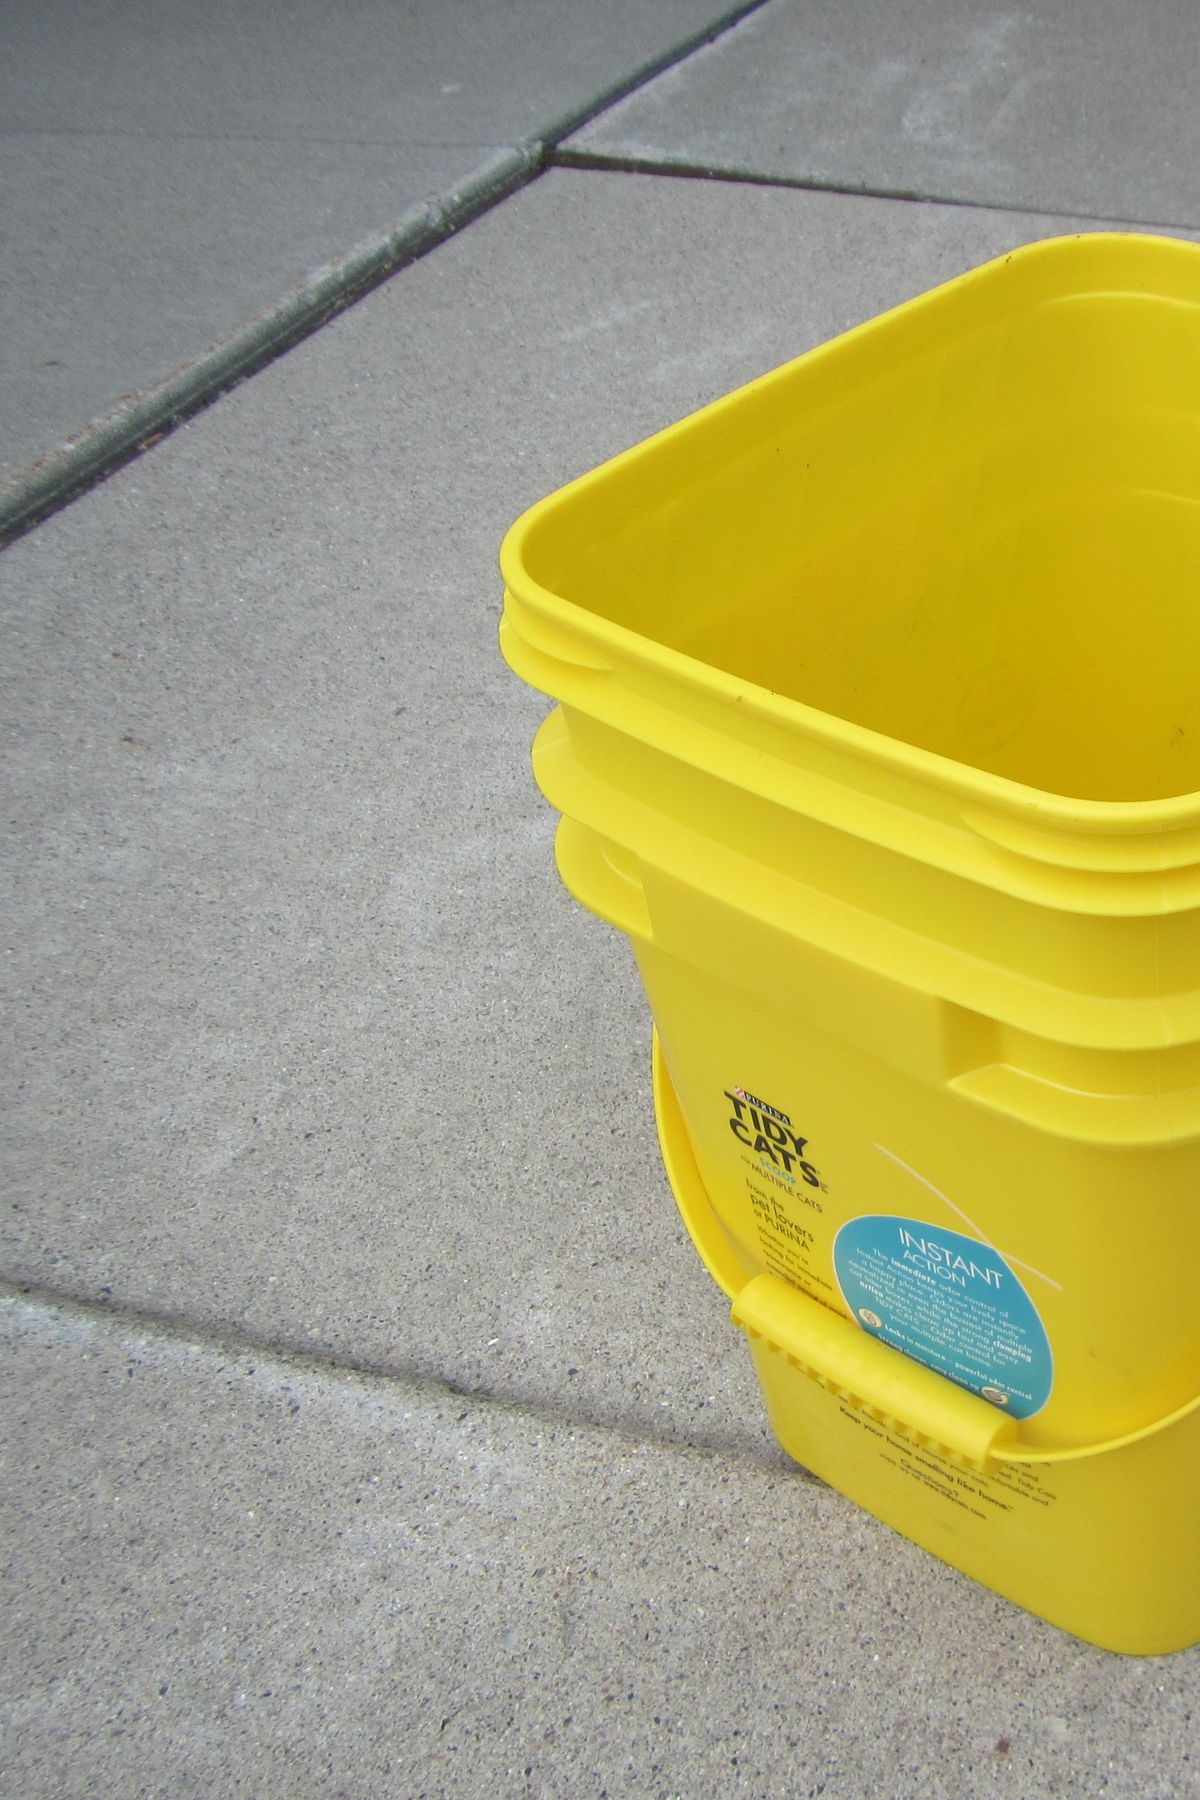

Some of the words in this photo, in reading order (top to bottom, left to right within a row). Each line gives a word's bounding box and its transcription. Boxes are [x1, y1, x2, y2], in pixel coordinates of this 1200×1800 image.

[724, 1090, 808, 1157] TIDY
[745, 1092, 791, 1125] PURINA
[729, 1118, 819, 1187] CATS
[759, 1157, 796, 1184] SCOOP
[746, 1178, 768, 1200] from
[770, 1196, 785, 1212] the
[752, 1163, 795, 1196] MULTIPLE
[797, 1192, 823, 1213] CATS
[750, 1194, 770, 1214] pet
[772, 1201, 815, 1243] lovers
[764, 1214, 811, 1252] PURINA
[873, 1248, 888, 1260] The
[939, 1282, 960, 1297] odor
[964, 1292, 996, 1314] control
[998, 1307, 1008, 1319] of
[899, 1228, 1003, 1288] INSTANT
[903, 1250, 966, 1287] ACTION
[848, 1259, 893, 1286] neutralized
[932, 1302, 946, 1313] the
[997, 1331, 1032, 1354] multiple
[856, 1247, 883, 1266] Instant
[887, 1264, 913, 1281] Action
[917, 1279, 944, 1296] keeps
[948, 1296, 967, 1309] your
[971, 1304, 995, 1321] lively
[999, 1318, 1026, 1336] space
[860, 1280, 883, 1296] action
[886, 1296, 911, 1312] makes
[915, 1310, 938, 1326] clean
[958, 1331, 973, 1342] fast
[976, 1339, 994, 1353] and
[870, 1261, 896, 1281] happy
[930, 1293, 959, 1312] Odors
[963, 1311, 977, 1322] are
[981, 1317, 1019, 1341] instantly
[876, 1297, 893, 1310] TIDY
[930, 1326, 955, 1342] Odor
[958, 1338, 989, 1358] control
[890, 1313, 907, 1326] your
[910, 1322, 945, 1346] multiple
[917, 1304, 940, 1319] while
[944, 1316, 958, 1328] the
[962, 1326, 989, 1344] strong
[993, 1338, 1031, 1364] clumping
[885, 1323, 905, 1338] Locks
[915, 1342, 945, 1359] moisture
[955, 1361, 986, 1379] powerful
[989, 1376, 1004, 1387] odor
[1007, 1384, 1031, 1400] control
[840, 1405, 862, 1425] Keep
[863, 1423, 884, 1438] your
[886, 1434, 912, 1457] home
[915, 1455, 954, 1483] smelling
[957, 1477, 976, 1493] like
[900, 1458, 959, 1497] Questions?
